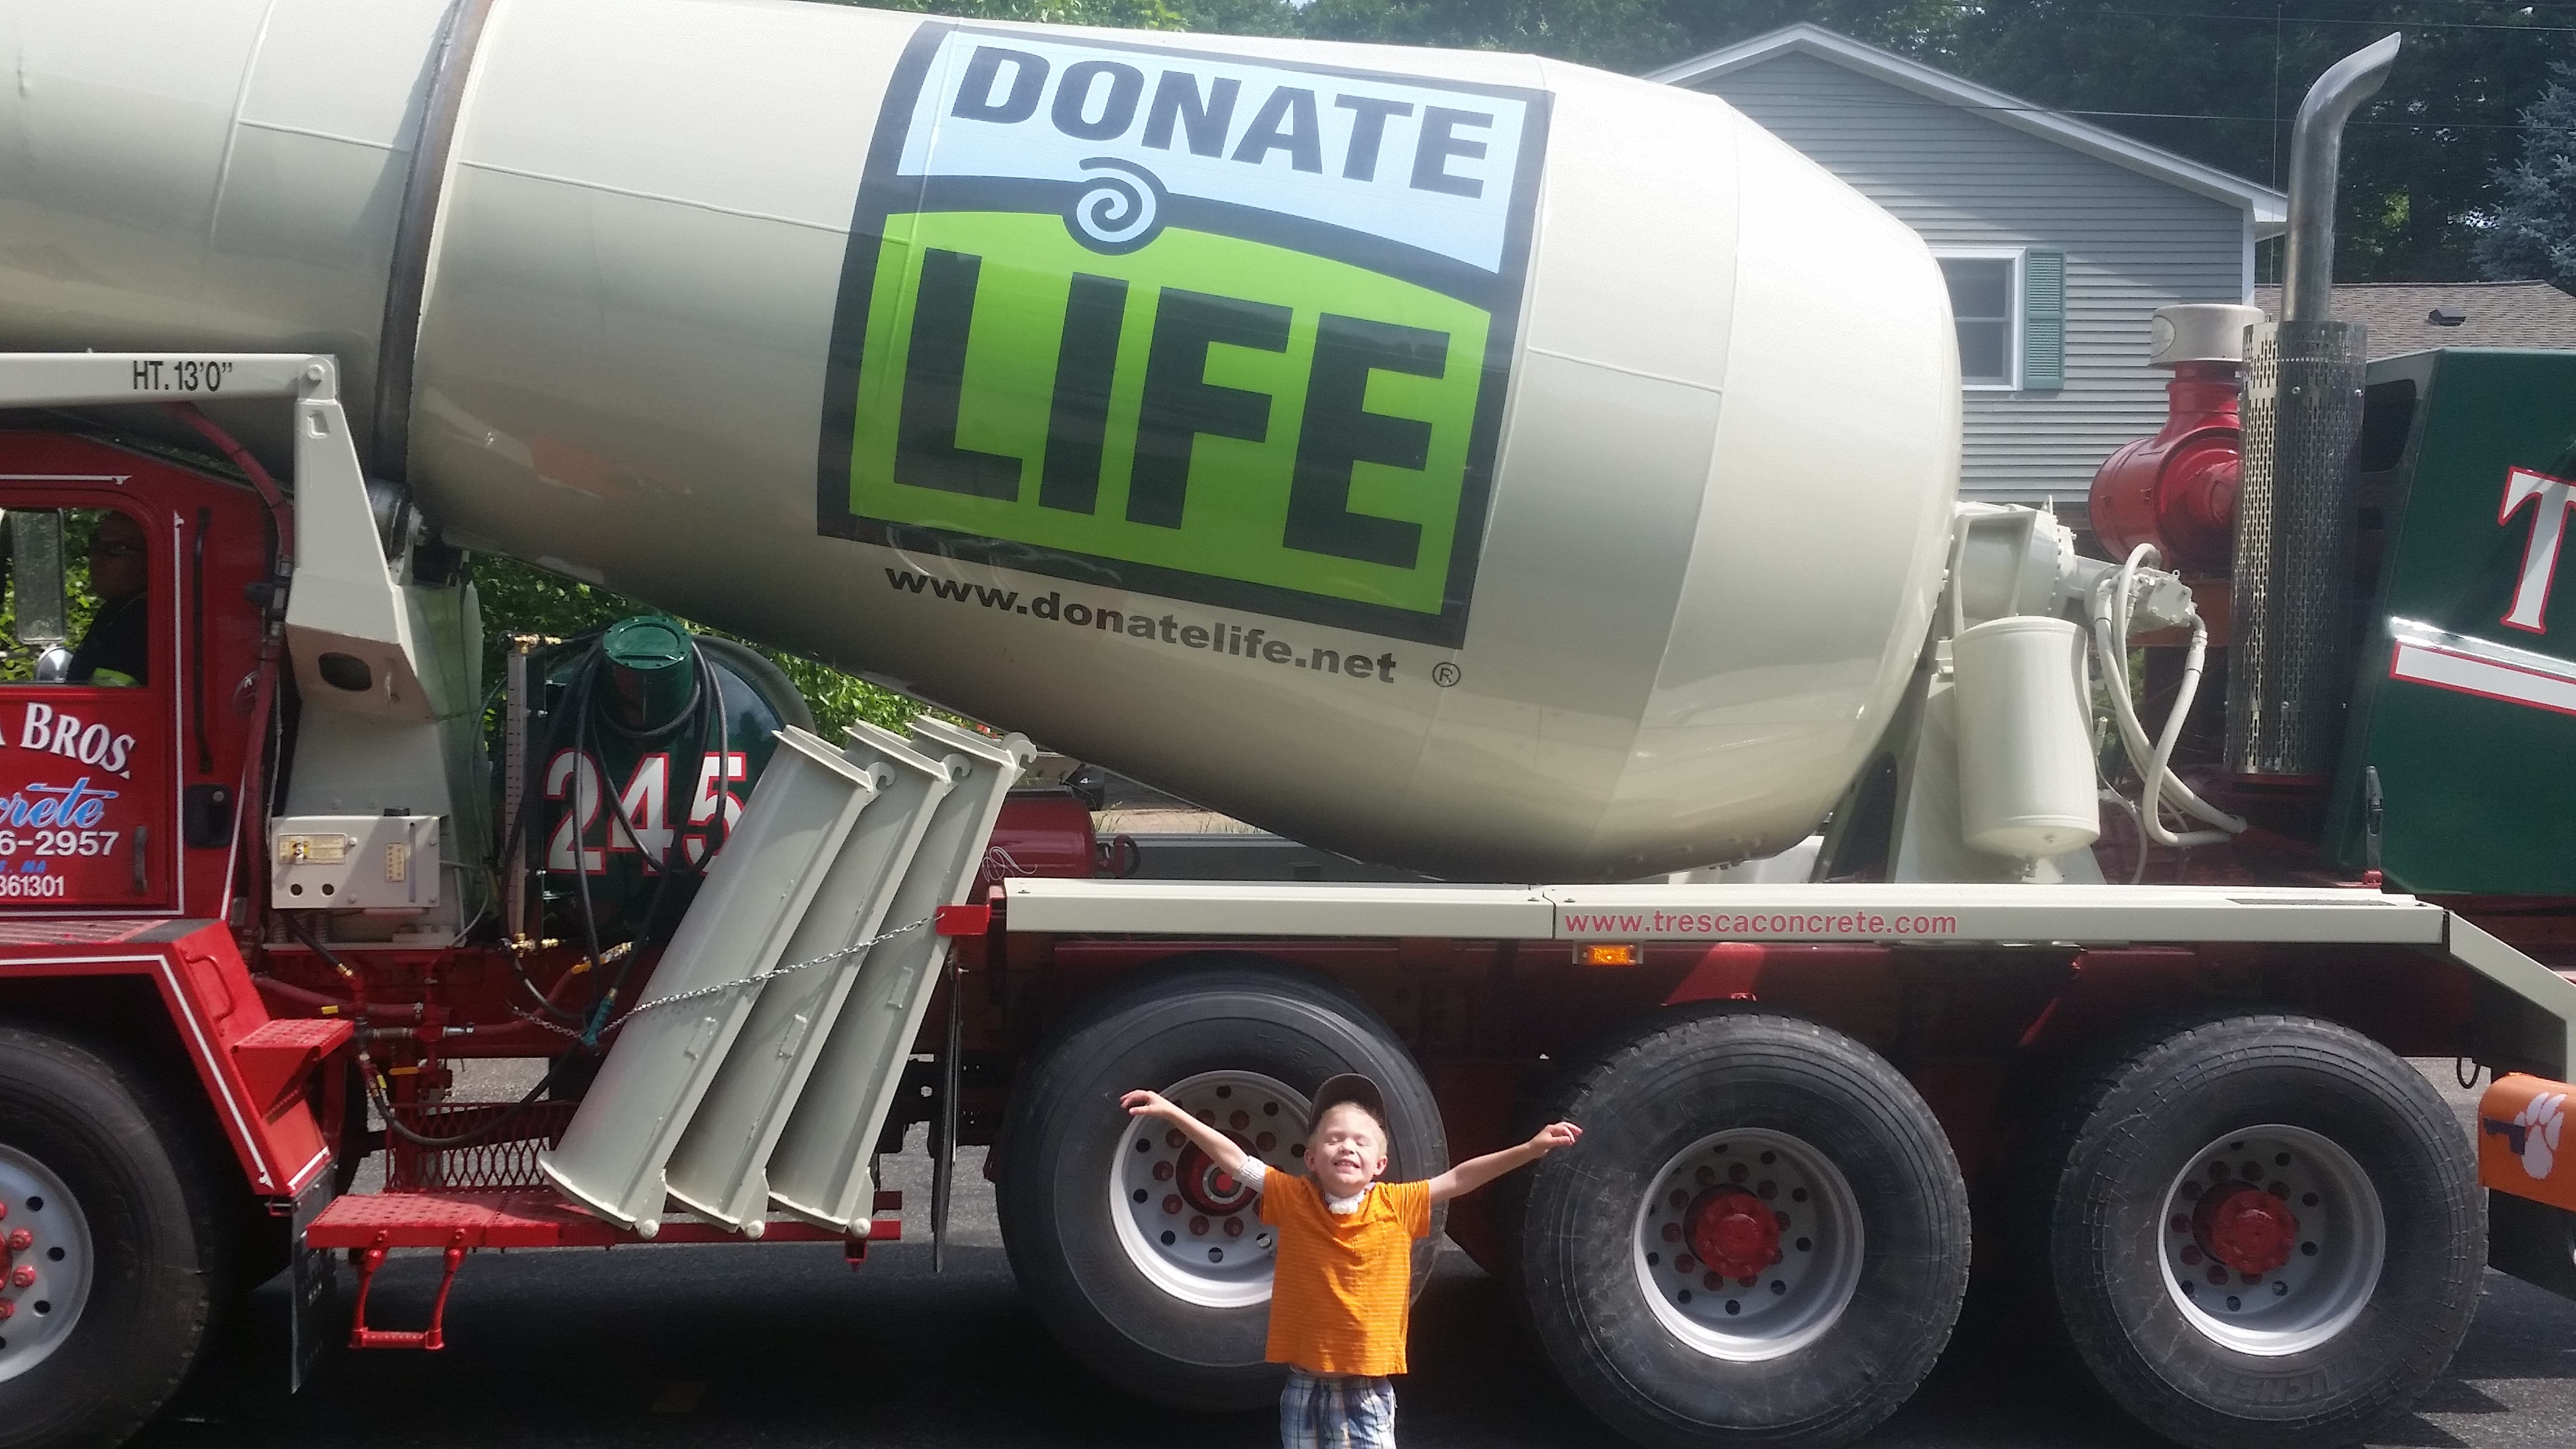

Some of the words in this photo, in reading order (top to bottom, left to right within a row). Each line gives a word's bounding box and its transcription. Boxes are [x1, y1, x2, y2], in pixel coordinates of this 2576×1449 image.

[951, 46, 1494, 199] DONATE
[894, 247, 1450, 569] LIFE
[885, 567, 1397, 683] www.donatelife.net
[19, 702, 136, 780] BROS.
[546, 747, 746, 876] 245
[1565, 910, 1957, 934] www.trescaconcrete.com
